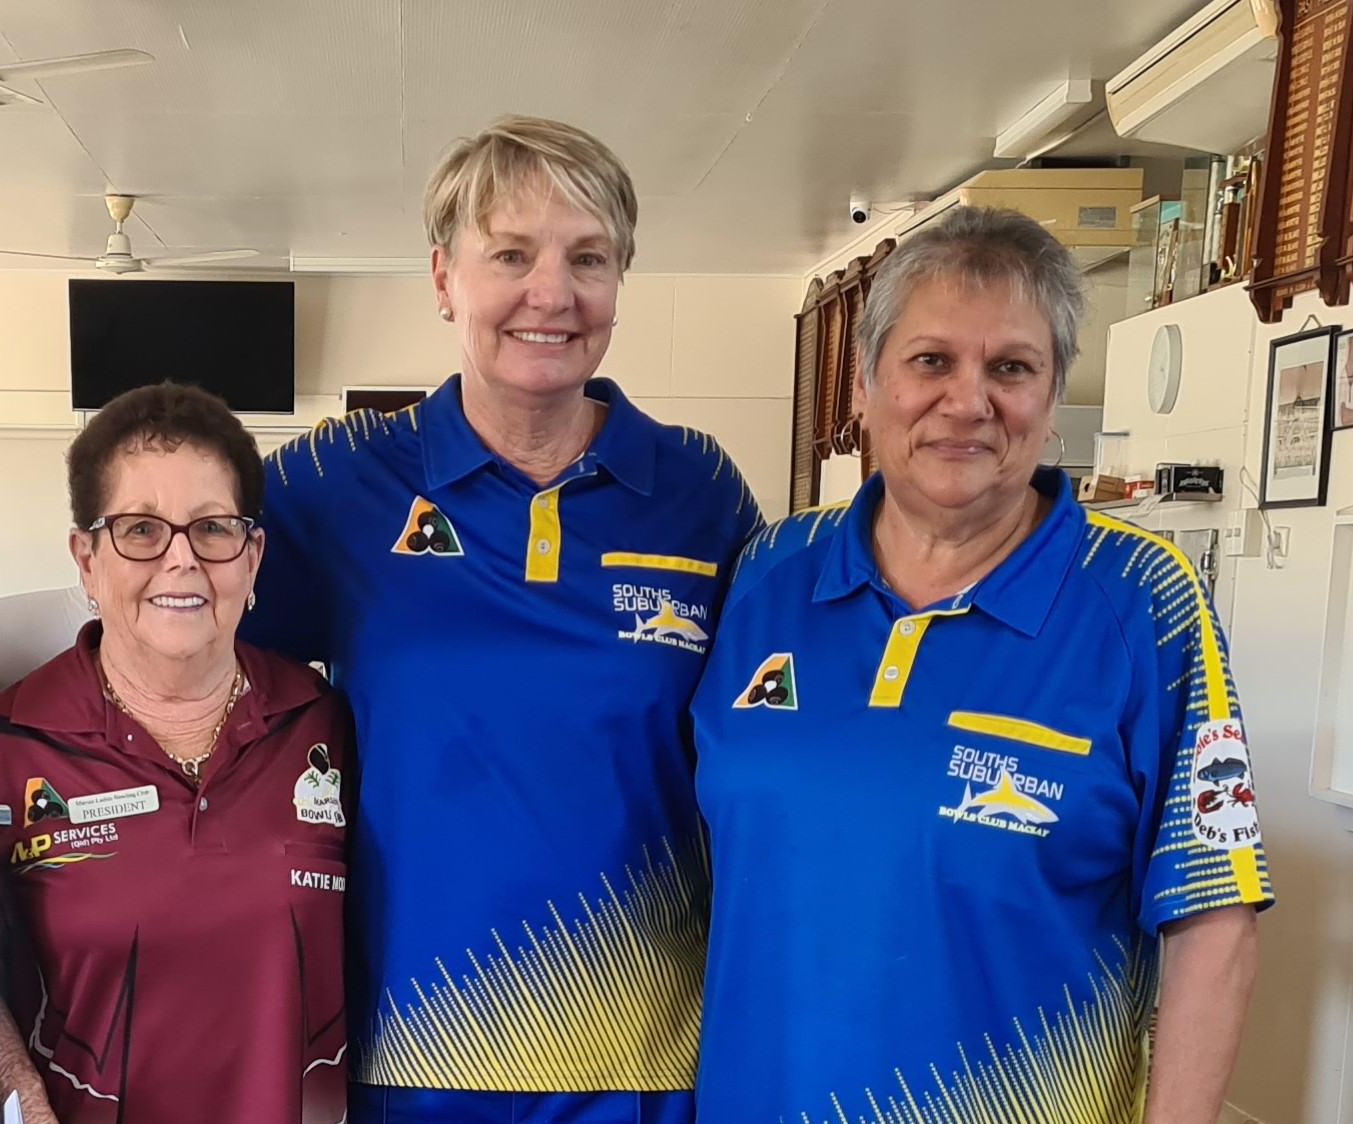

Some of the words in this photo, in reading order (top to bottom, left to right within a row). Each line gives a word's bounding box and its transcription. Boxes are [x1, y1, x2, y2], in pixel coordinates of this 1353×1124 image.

[613, 584, 671, 600] SOUTHS
[613, 597, 708, 620] SUBURBAN
[952, 745, 1019, 772] SOUTHS
[947, 760, 1064, 801] SUBURBAN
[82, 800, 147, 819] PRESIDENT
[978, 813, 1006, 829] CLUB
[1194, 812, 1227, 843] Deb's
[53, 823, 116, 844] SERVICES
[291, 869, 330, 890] KATIE
